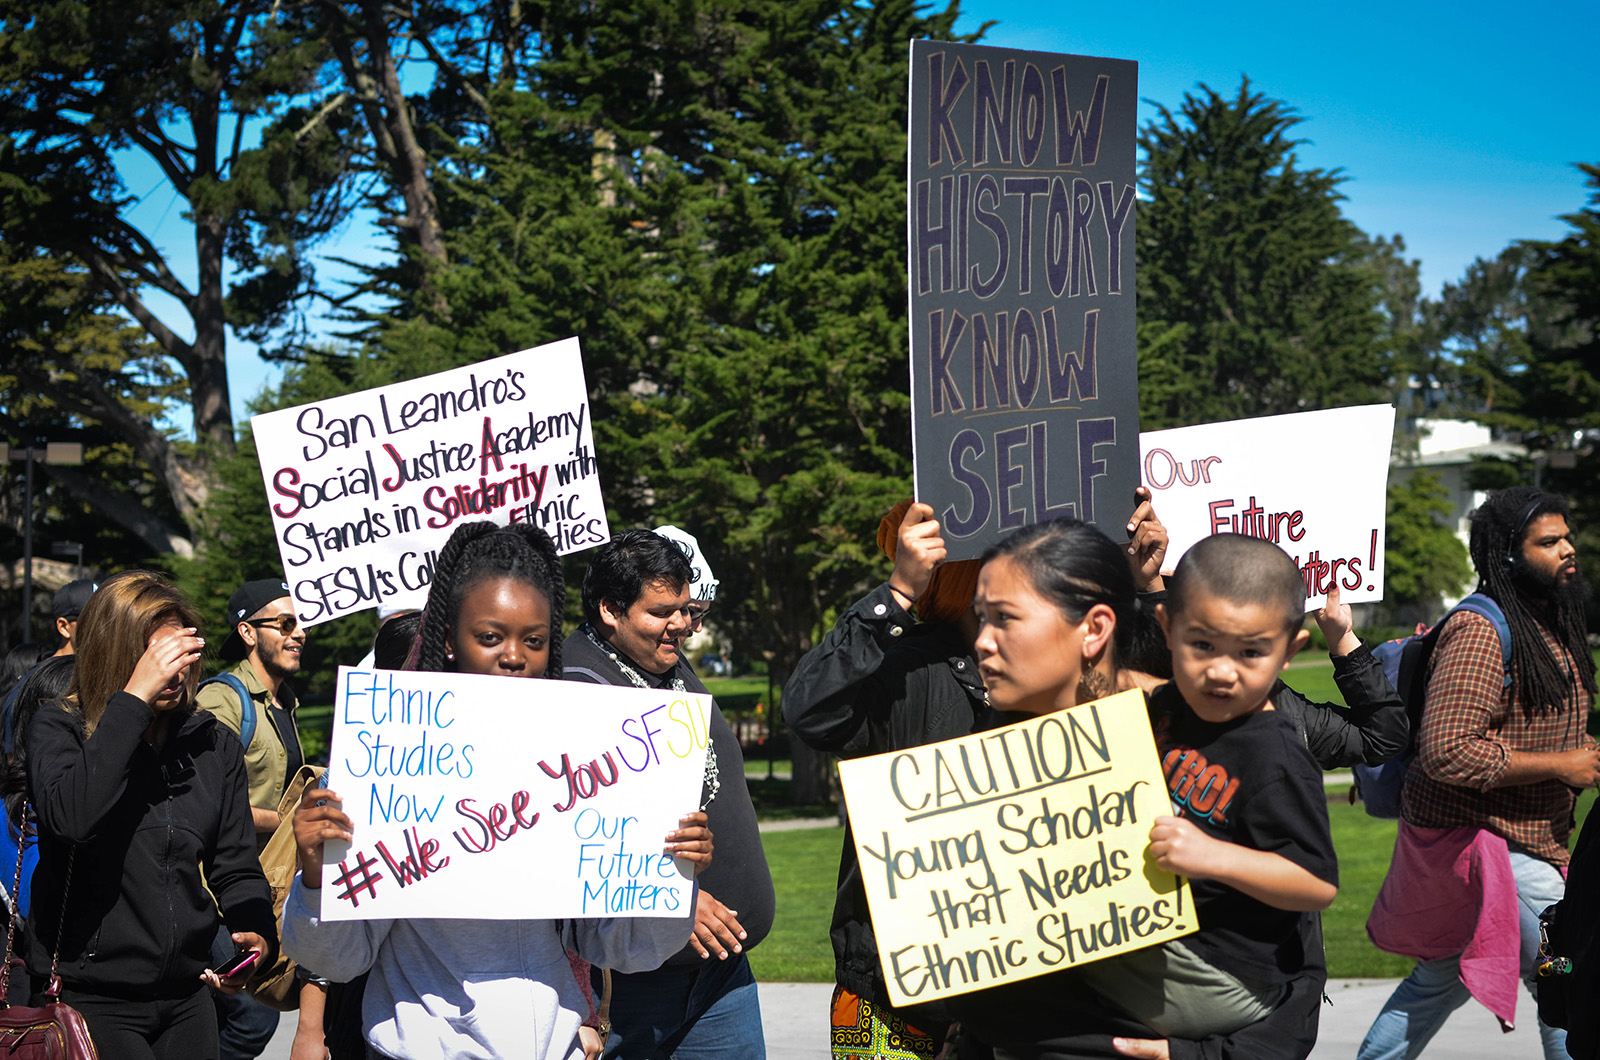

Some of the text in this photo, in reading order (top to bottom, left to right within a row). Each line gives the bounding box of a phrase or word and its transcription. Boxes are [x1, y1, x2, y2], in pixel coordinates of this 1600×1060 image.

[927, 51, 1110, 170] KNOW
[916, 173, 1137, 300] HISTORY
[928, 306, 1100, 418] KNOW
[273, 403, 585, 519] Social Justice Academy
[296, 369, 526, 461] San Leandro's
[283, 445, 598, 566] Stands in Solidarity with
[942, 416, 1117, 541] SELF
[1144, 448, 1222, 490] Our
[551, 518, 605, 552] dies
[1208, 496, 1306, 543] Future
[295, 563, 398, 622] SFSU's
[399, 550, 438, 591] Coll
[344, 671, 455, 728] Ethnic
[345, 730, 474, 779] Studies
[453, 790, 540, 853] See
[537, 750, 619, 812] You
[616, 697, 708, 772] SFSU
[890, 705, 1111, 811] CAUTION
[369, 783, 445, 825] Now
[574, 808, 638, 840] Our
[863, 780, 1150, 899] Young Scholar
[578, 841, 676, 879] Future
[583, 879, 680, 914] Matters
[927, 840, 1132, 938] that Needs
[889, 874, 1187, 997] Ethnic Studies!
